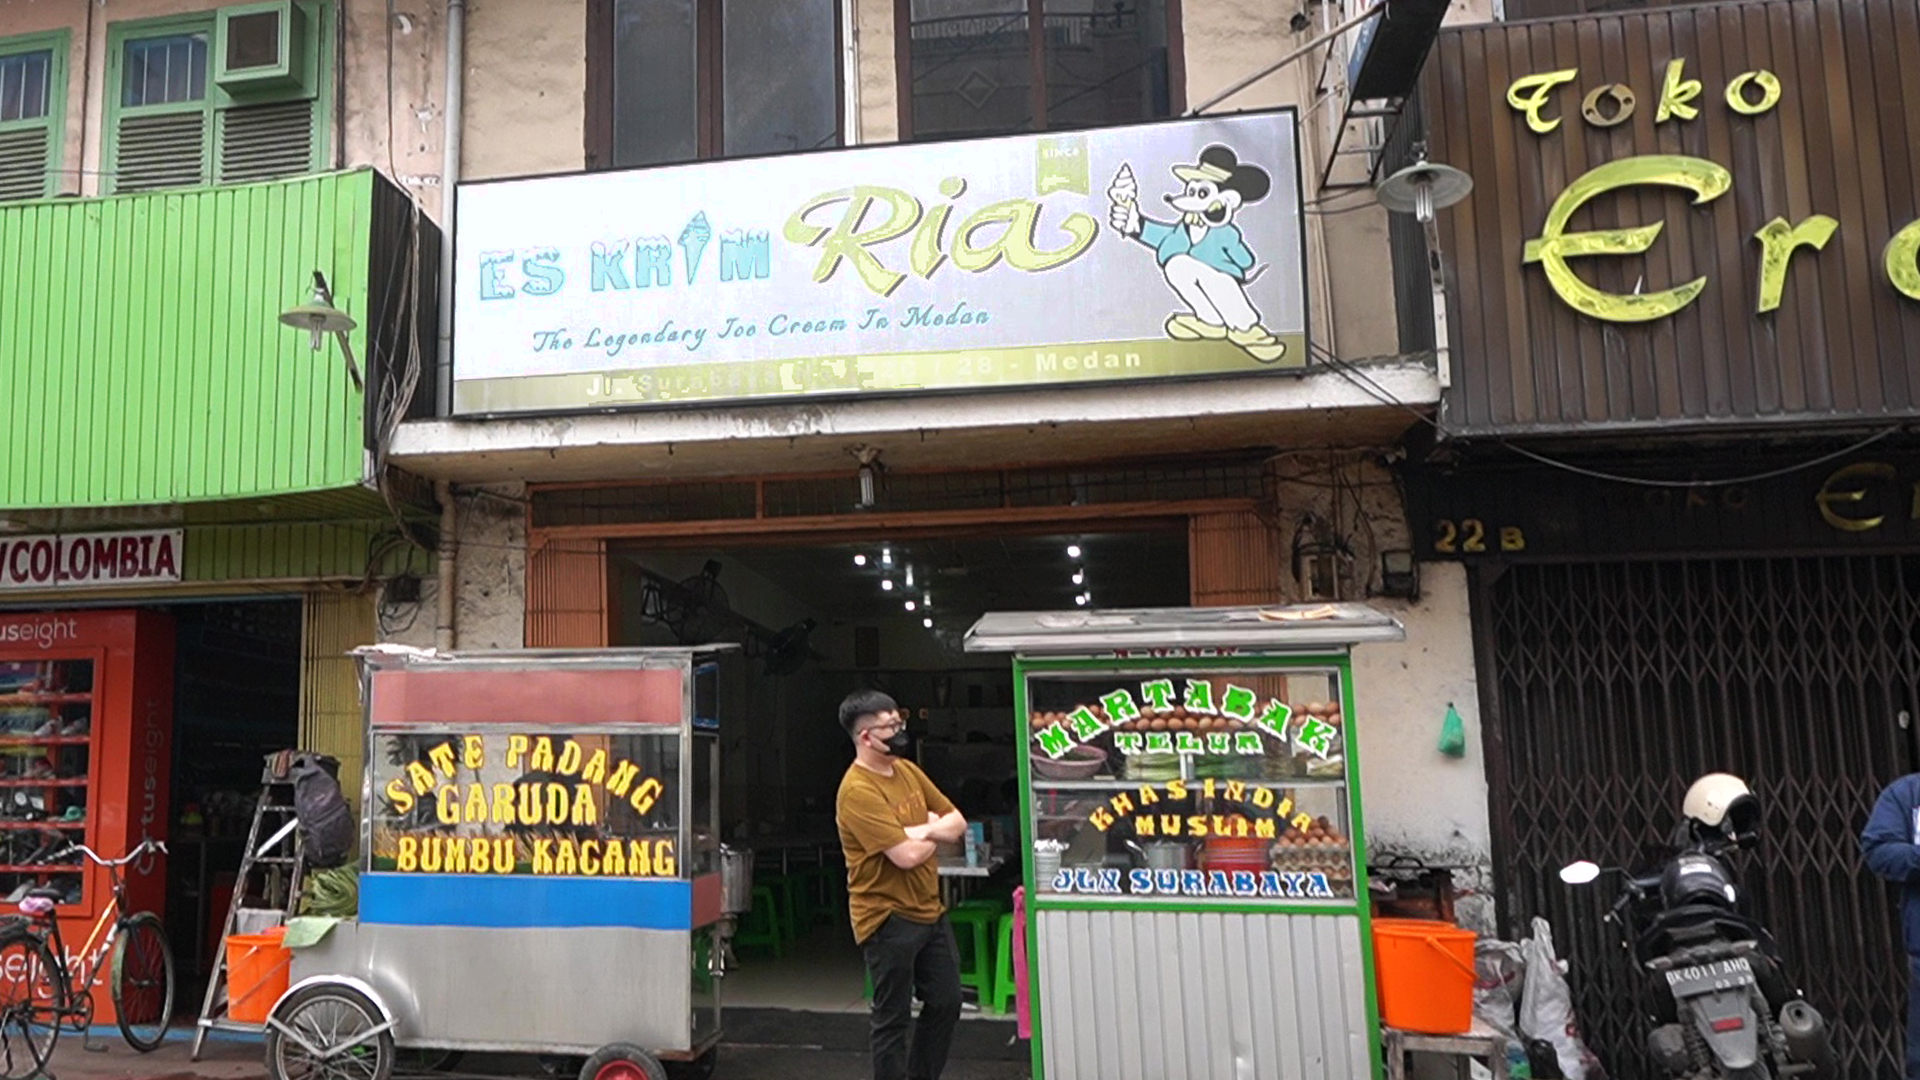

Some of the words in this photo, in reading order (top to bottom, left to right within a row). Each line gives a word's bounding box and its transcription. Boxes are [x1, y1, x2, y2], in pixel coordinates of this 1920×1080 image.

[1506, 57, 1782, 134] Toko
[478, 246, 566, 301] ES
[782, 176, 1100, 298] Ria
[532, 328, 574, 353] The
[584, 320, 708, 357] Legendary
[767, 313, 847, 337] Cream
[858, 307, 890, 330] In
[900, 301, 990, 329] Medan
[1035, 350, 1142, 373] Medan
[1434, 519, 1486, 552] 22
[1034, 678, 1338, 760] MARTABAK
[1114, 730, 1265, 756] TELUR
[386, 734, 484, 814] SATE
[506, 733, 663, 816] PADANG
[436, 781, 598, 827] GARUDA
[1088, 778, 1188, 833] KHAS
[1202, 777, 1312, 835] INDIA
[1134, 814, 1277, 839] MUSLIM
[396, 836, 515, 875] BUMBU
[532, 838, 676, 877] KACANG
[1051, 868, 1123, 895] JLN
[1129, 868, 1335, 898] SURABAYA
